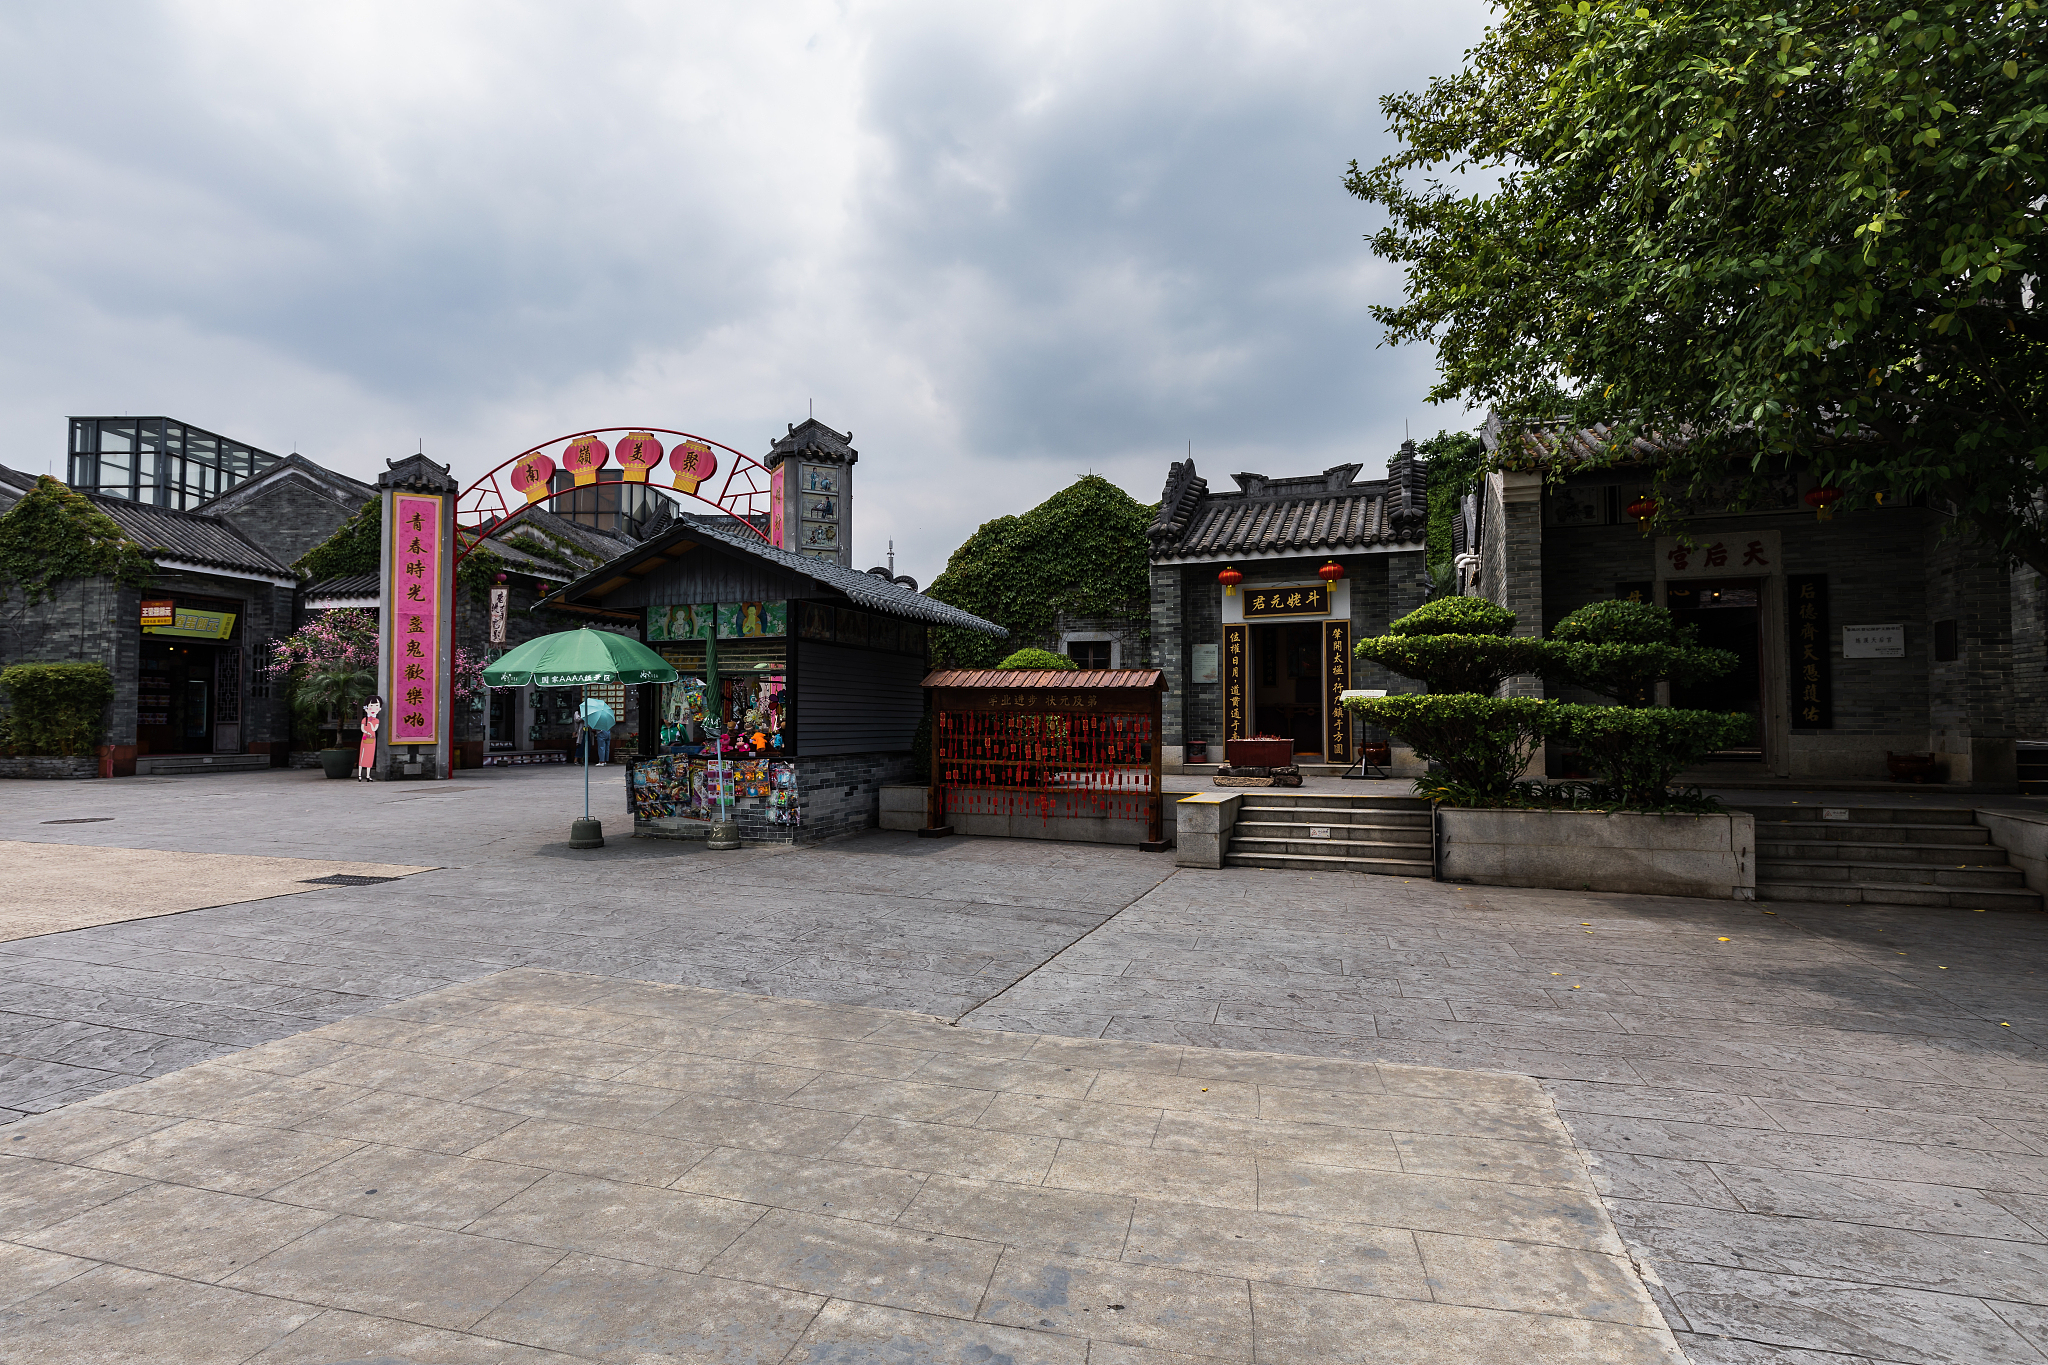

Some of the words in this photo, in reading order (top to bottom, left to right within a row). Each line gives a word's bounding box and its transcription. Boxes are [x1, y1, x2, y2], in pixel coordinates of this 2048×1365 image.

[405, 511, 428, 602] 青春時光
[1251, 589, 1321, 612] 斗姥元君
[174, 614, 220, 632] 元朗蛋卷
[988, 694, 1038, 707] 学业进步
[1045, 694, 1098, 707] 状元及第
